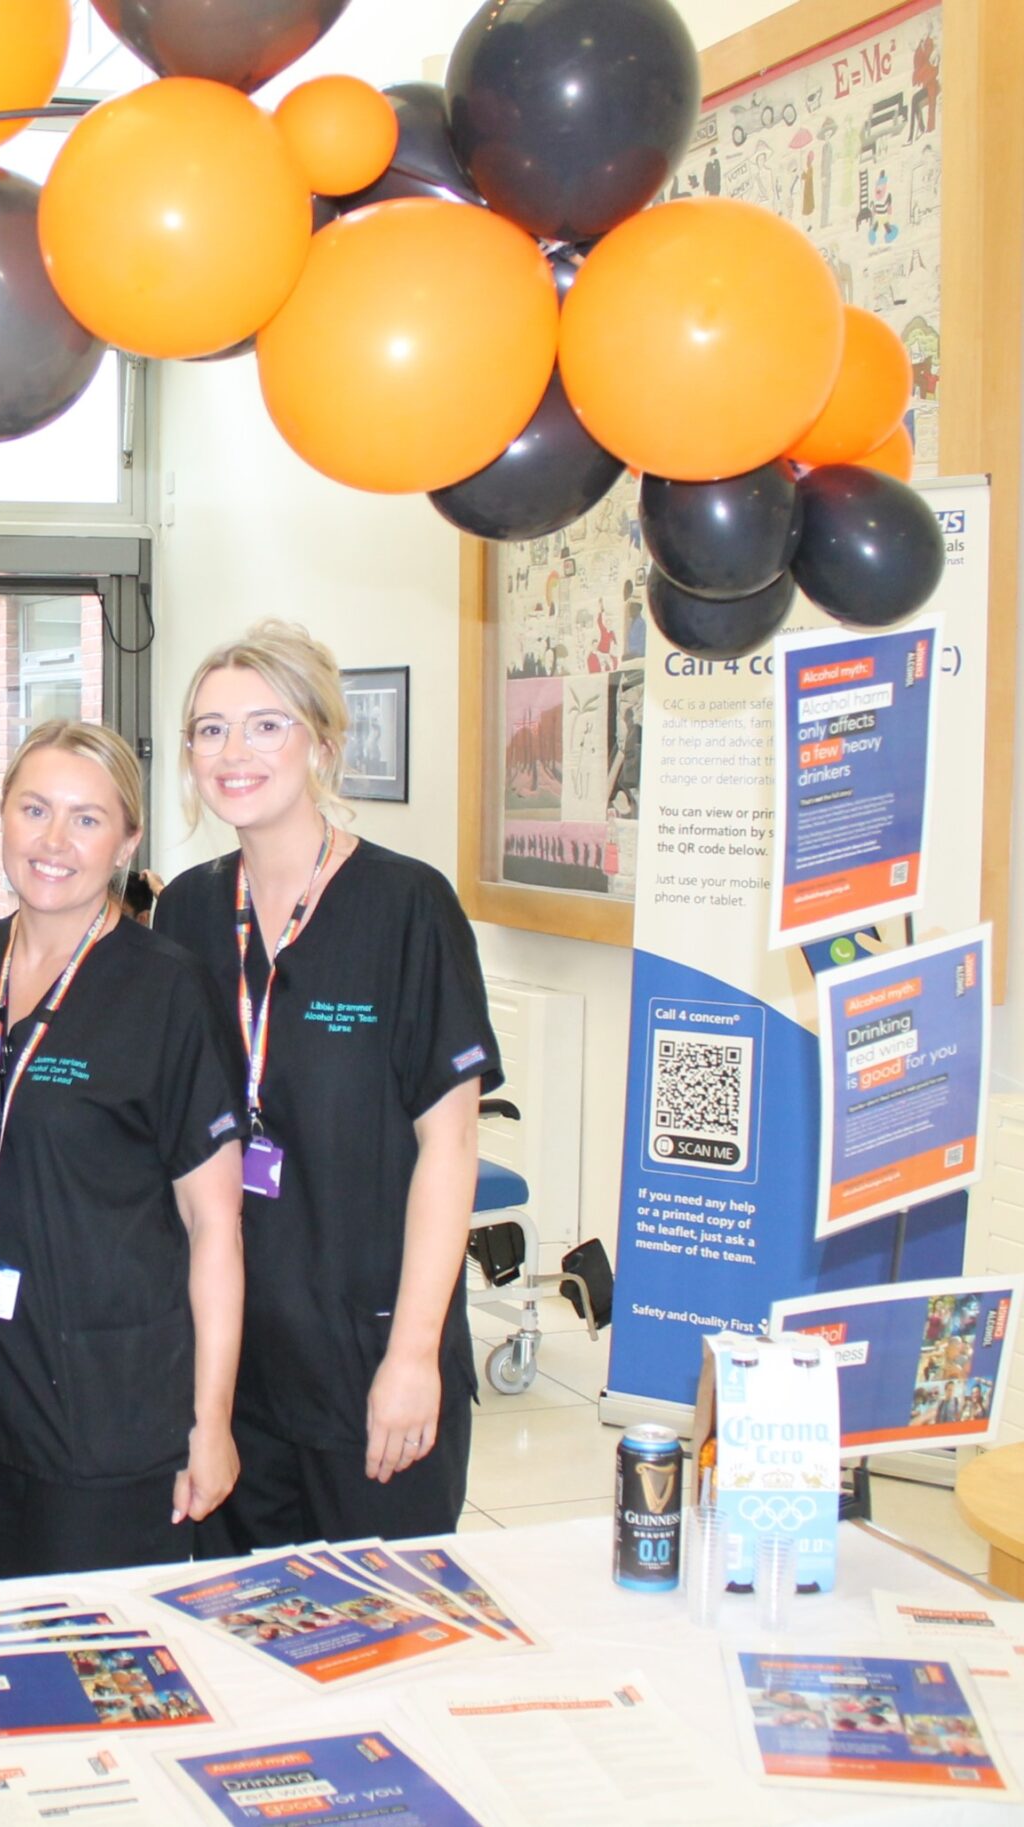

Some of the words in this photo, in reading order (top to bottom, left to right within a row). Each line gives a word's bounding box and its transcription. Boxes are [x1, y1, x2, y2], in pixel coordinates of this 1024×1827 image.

[933, 511, 965, 533] HS
[945, 557, 964, 566] rust
[723, 656, 740, 676] 4
[803, 667, 840, 684] Alcohol
[840, 661, 869, 680] myth:
[662, 699, 685, 710] C4C
[687, 699, 696, 710] is
[698, 702, 706, 710] a
[709, 699, 746, 714] patient
[750, 697, 774, 711] safe
[802, 691, 851, 716] Alcohol
[853, 688, 891, 705] harm
[662, 718, 688, 729] adult
[691, 718, 746, 732] inpatients,
[798, 721, 827, 743] only
[829, 713, 876, 735] affects
[661, 736, 676, 747] for
[678, 736, 702, 749] help
[705, 736, 726, 747] and
[728, 737, 764, 748] advice
[800, 752, 811, 764] a
[813, 743, 840, 761] few
[842, 736, 883, 753] heavy
[660, 757, 677, 766] are
[679, 754, 736, 767] concerned
[739, 755, 761, 767] that
[660, 772, 698, 787] change
[700, 775, 713, 785] or
[716, 773, 775, 786] deteriorati
[797, 763, 852, 787] drinkers
[659, 805, 679, 817] You
[681, 808, 703, 817] can
[705, 807, 734, 819] view
[735, 810, 749, 819] or
[751, 807, 775, 821] prin
[658, 823, 676, 835] the
[678, 823, 747, 837] information
[750, 826, 767, 841] by
[657, 841, 675, 853] the
[677, 842, 696, 855] QR
[698, 842, 726, 855] code
[728, 843, 769, 857] below.
[656, 874, 675, 885] Just
[678, 876, 698, 886] use
[700, 878, 727, 889] your
[729, 877, 772, 890] mobile
[654, 891, 691, 904] phone
[693, 895, 707, 905] or
[709, 893, 747, 907] tablet.
[847, 990, 886, 1011] Alcohol
[304, 1011, 334, 1022] Alcohol
[336, 1013, 355, 1022] Care
[357, 1013, 378, 1023] Team
[655, 1008, 677, 1021] Call
[678, 1010, 686, 1021] 4
[328, 1023, 353, 1032] Nurse
[847, 1015, 912, 1047] Drinking
[849, 1048, 876, 1068] red
[879, 1037, 916, 1057] wine
[847, 1075, 858, 1090] is
[860, 1058, 903, 1088] good
[906, 1053, 927, 1070] for
[929, 1043, 958, 1066] you
[678, 1141, 712, 1158] SCAN
[713, 1146, 734, 1160] ME
[638, 1188, 648, 1198] If
[649, 1191, 671, 1203] you
[674, 1194, 703, 1207] need
[705, 1199, 727, 1213] any
[729, 1199, 756, 1216] help
[637, 1207, 650, 1216] or
[652, 1209, 660, 1218] a
[662, 1209, 705, 1224] printed
[707, 1216, 735, 1230] copy
[737, 1218, 752, 1230] of
[636, 1221, 656, 1233] the
[658, 1223, 698, 1240] leaflet,
[699, 1229, 723, 1244] just
[724, 1235, 746, 1246] ask
[747, 1238, 756, 1248] a
[635, 1239, 683, 1254] member
[685, 1244, 699, 1256] of
[700, 1247, 720, 1260] the
[723, 1250, 757, 1265] team.
[631, 1303, 666, 1321] Safety
[667, 1310, 688, 1322] and
[688, 1312, 729, 1329] Quality
[730, 1318, 755, 1333] First
[722, 1415, 835, 1450] Corona
[755, 1445, 804, 1465] Cero
[624, 1511, 681, 1527] GUINNESS
[638, 1539, 672, 1563] 0.0
[221, 1771, 314, 1792] Drinking
[233, 1788, 273, 1805] red
[277, 1783, 331, 1798] wine
[242, 1806, 261, 1818] is
[262, 1797, 324, 1817] good
[325, 1792, 358, 1806] for
[362, 1785, 405, 1803] you
